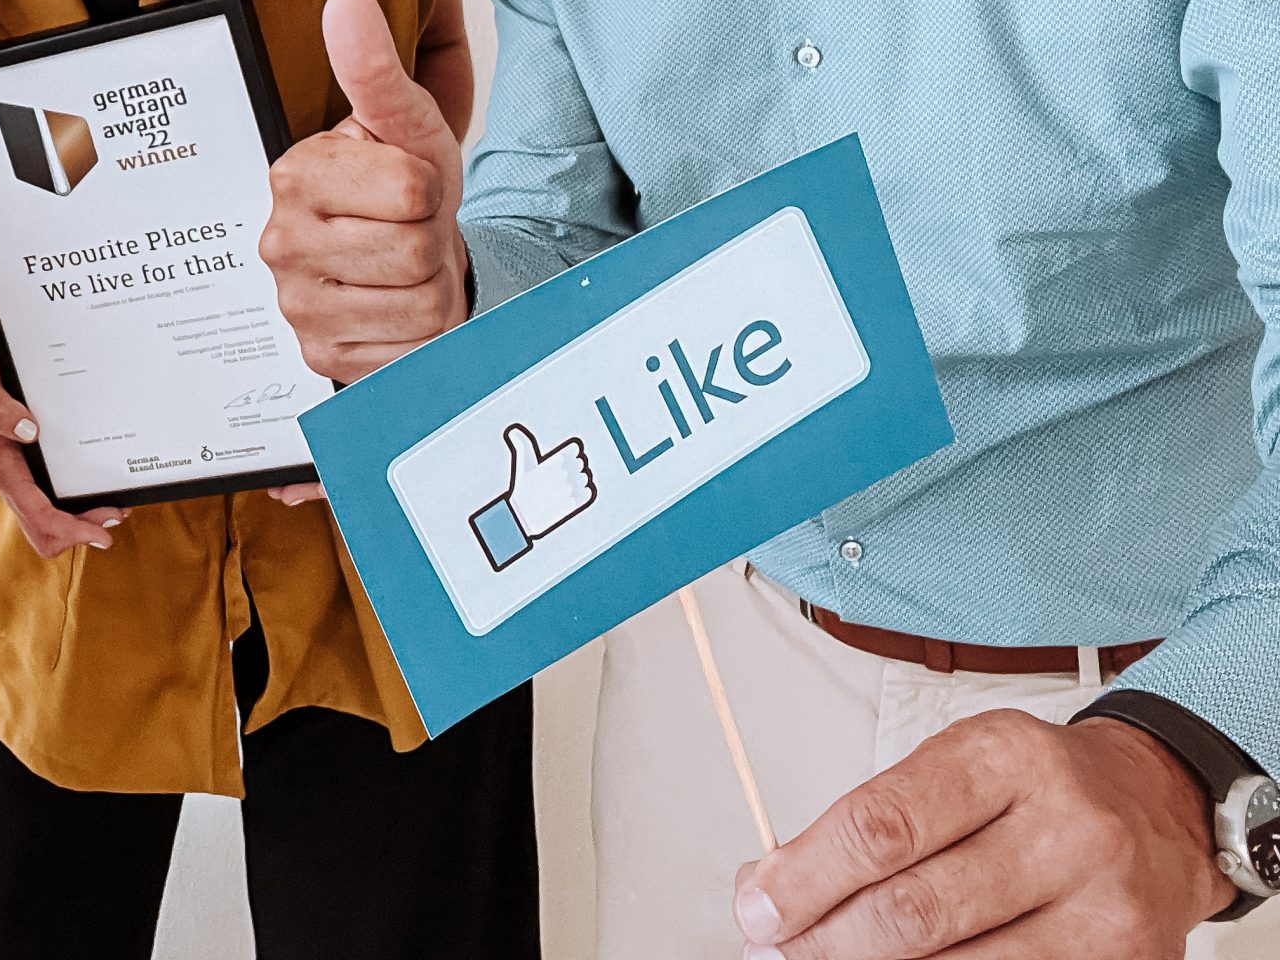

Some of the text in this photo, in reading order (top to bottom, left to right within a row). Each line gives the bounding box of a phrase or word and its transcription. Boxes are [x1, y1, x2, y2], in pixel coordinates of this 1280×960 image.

[93, 77, 177, 112] german
[122, 86, 188, 117] brand
[102, 112, 171, 139] award
[115, 142, 198, 171] winner
[22, 239, 140, 275] Favourite
[144, 221, 227, 251] Places
[40, 250, 244, 302] We live for that.
[594, 319, 793, 475] Like
[126, 455, 160, 466] German
[128, 458, 192, 473] Brand Institute
